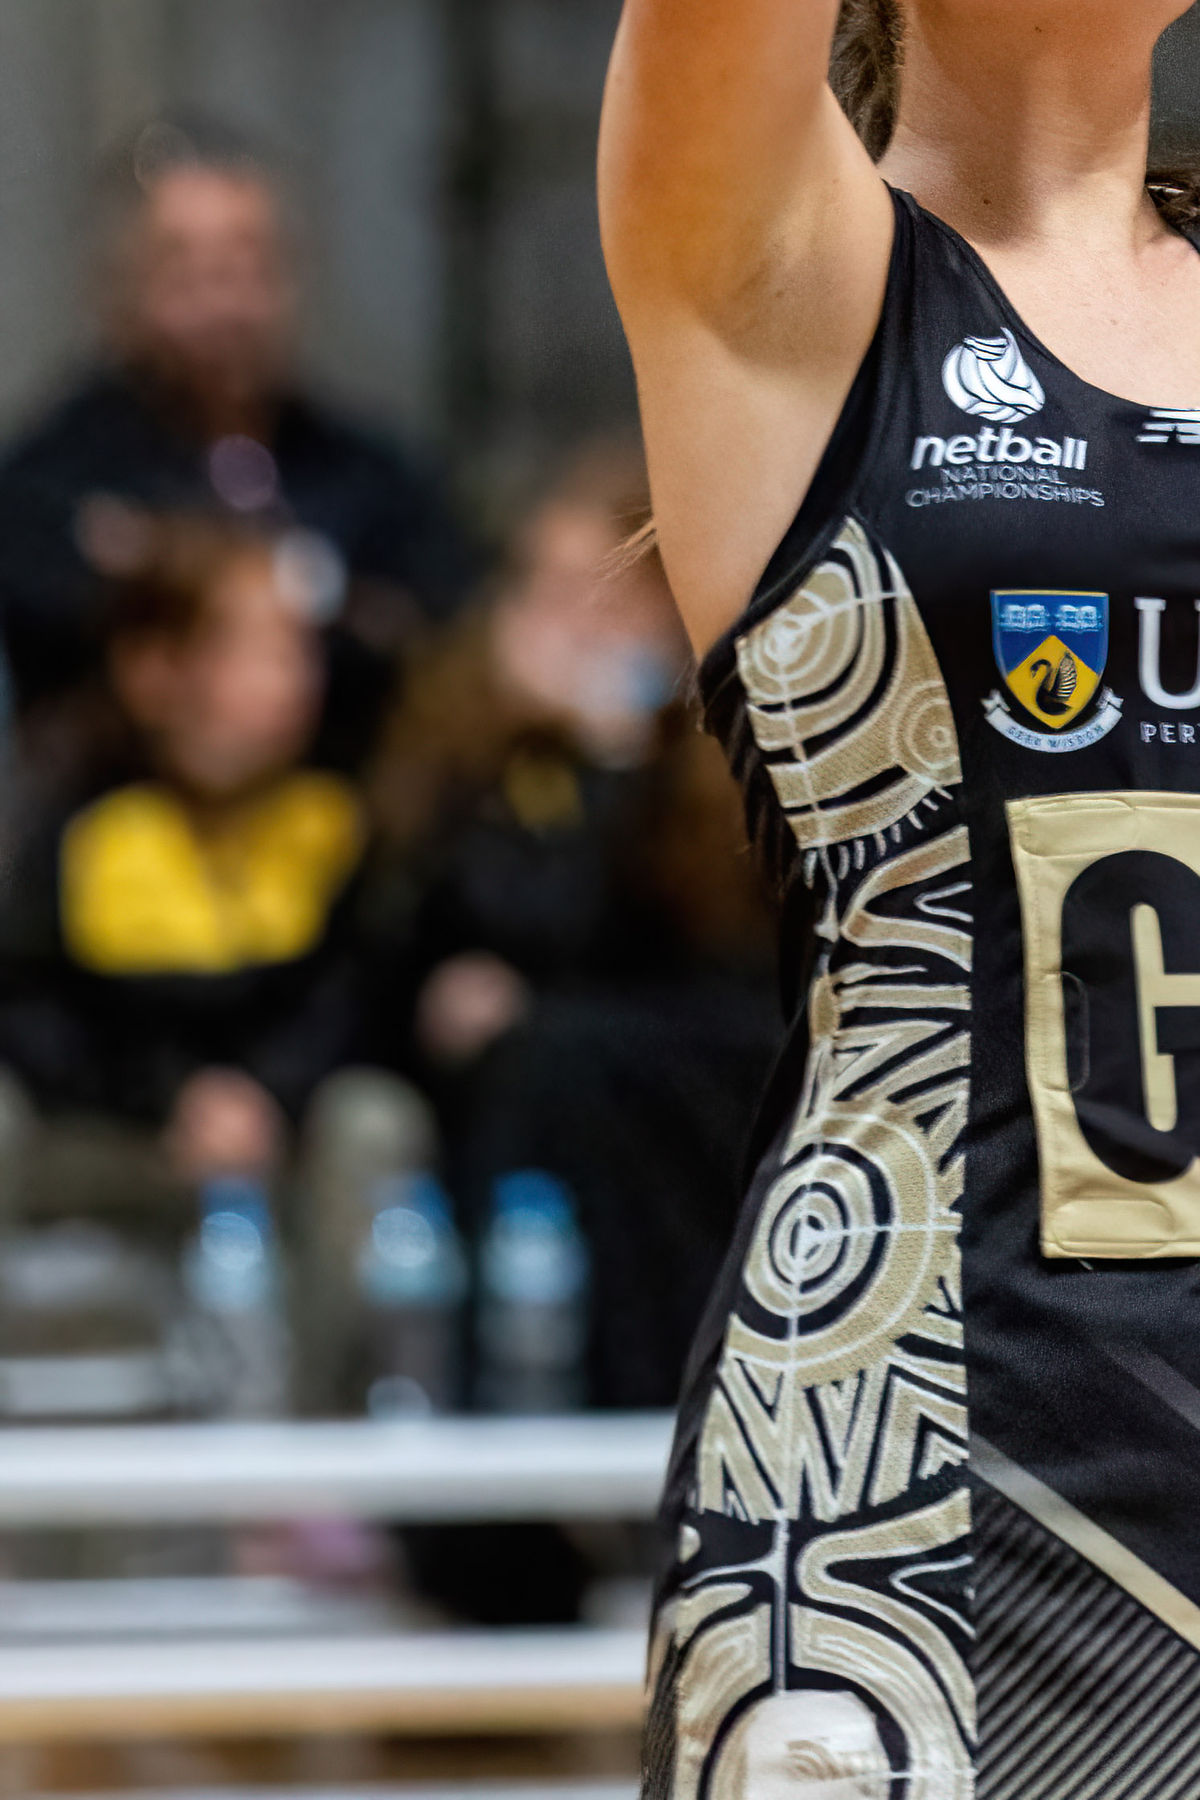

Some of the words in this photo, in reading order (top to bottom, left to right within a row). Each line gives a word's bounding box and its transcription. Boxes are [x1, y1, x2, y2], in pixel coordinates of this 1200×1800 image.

[910, 426, 1088, 470] netball
[939, 464, 1068, 486] NATIONAL
[905, 482, 1105, 507] CHAMPIONSHIPS
